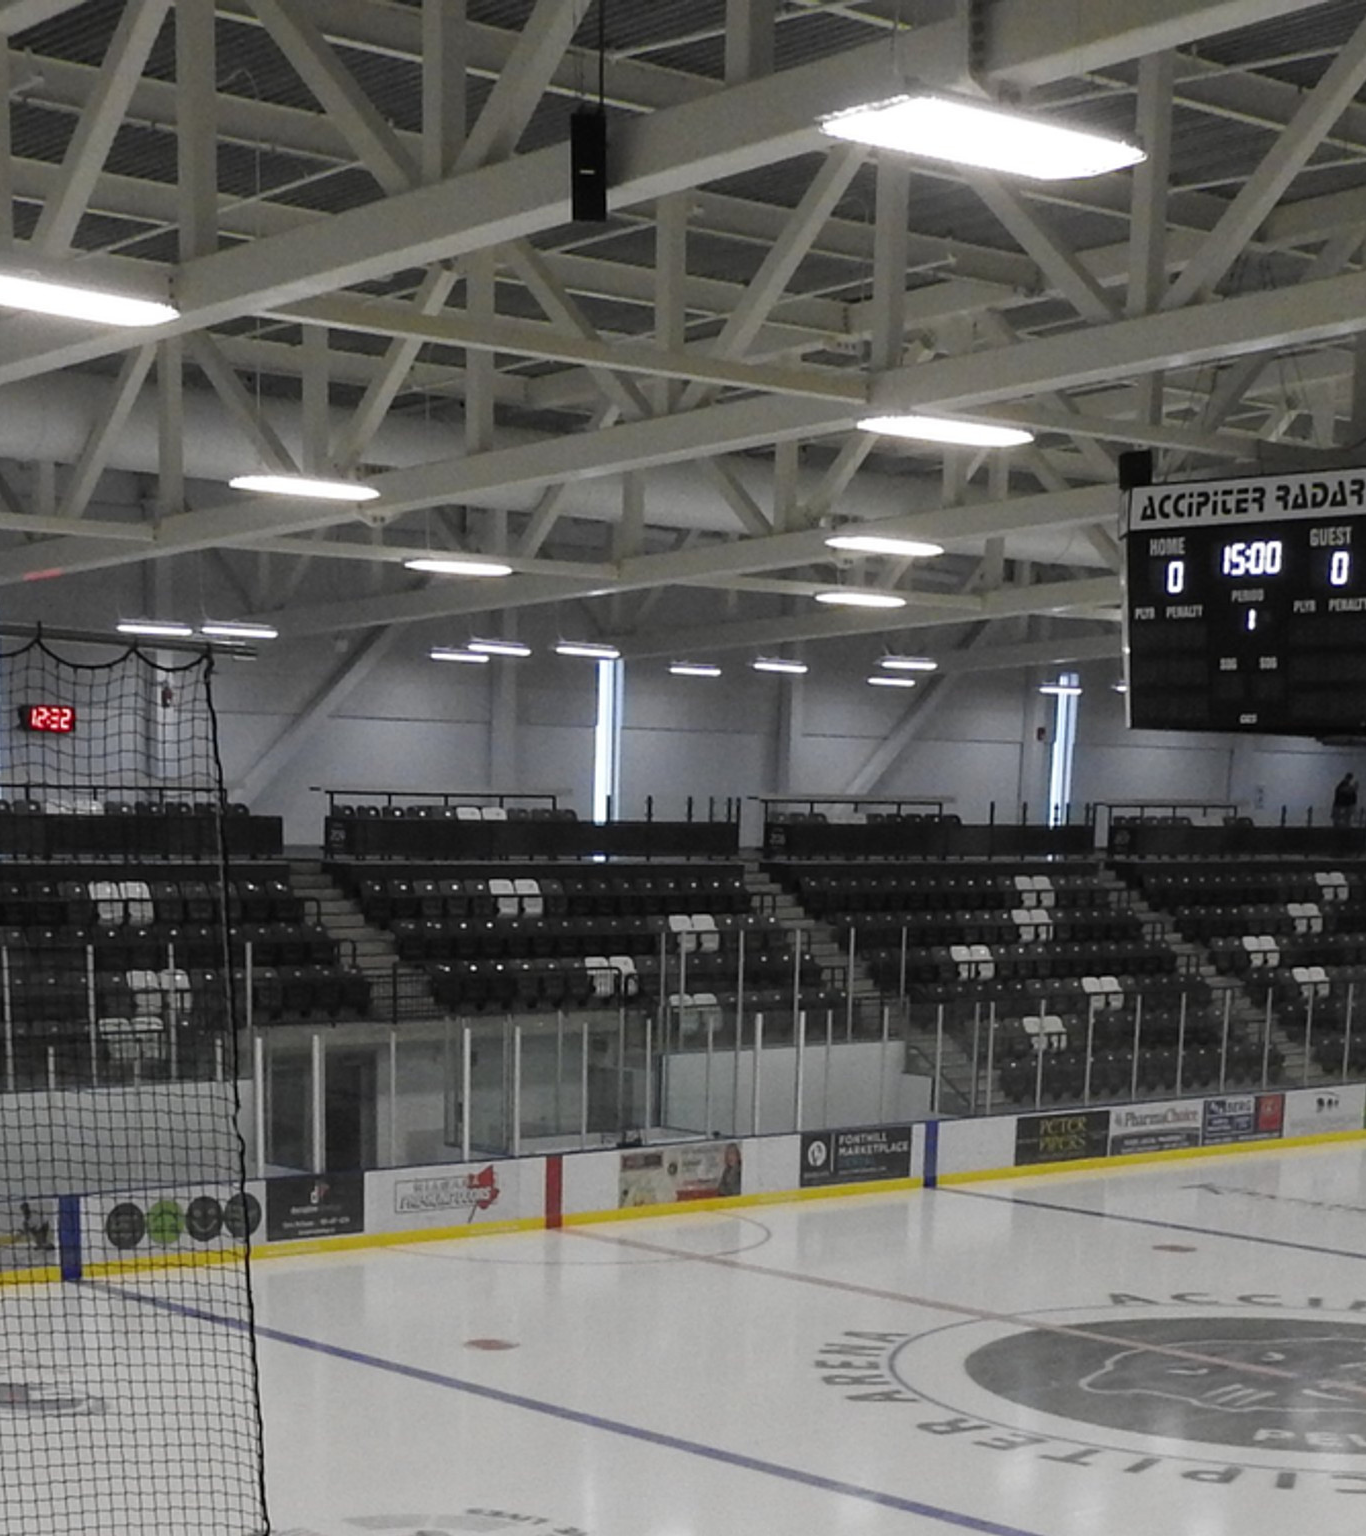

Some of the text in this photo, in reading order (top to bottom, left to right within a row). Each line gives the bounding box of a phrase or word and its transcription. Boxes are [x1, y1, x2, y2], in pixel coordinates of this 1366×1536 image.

[1140, 479, 1366, 521] ACCIPITER RADAR
[1150, 537, 1185, 556] HOME
[1310, 527, 1352, 546] GUEST
[1223, 541, 1282, 575] 15:00
[1330, 551, 1350, 585] 0
[1167, 561, 1185, 593] 0
[31, 707, 72, 730] 12:32
[838, 1131, 887, 1146] FONTHILL
[838, 1140, 909, 1156] MARKETPLACE
